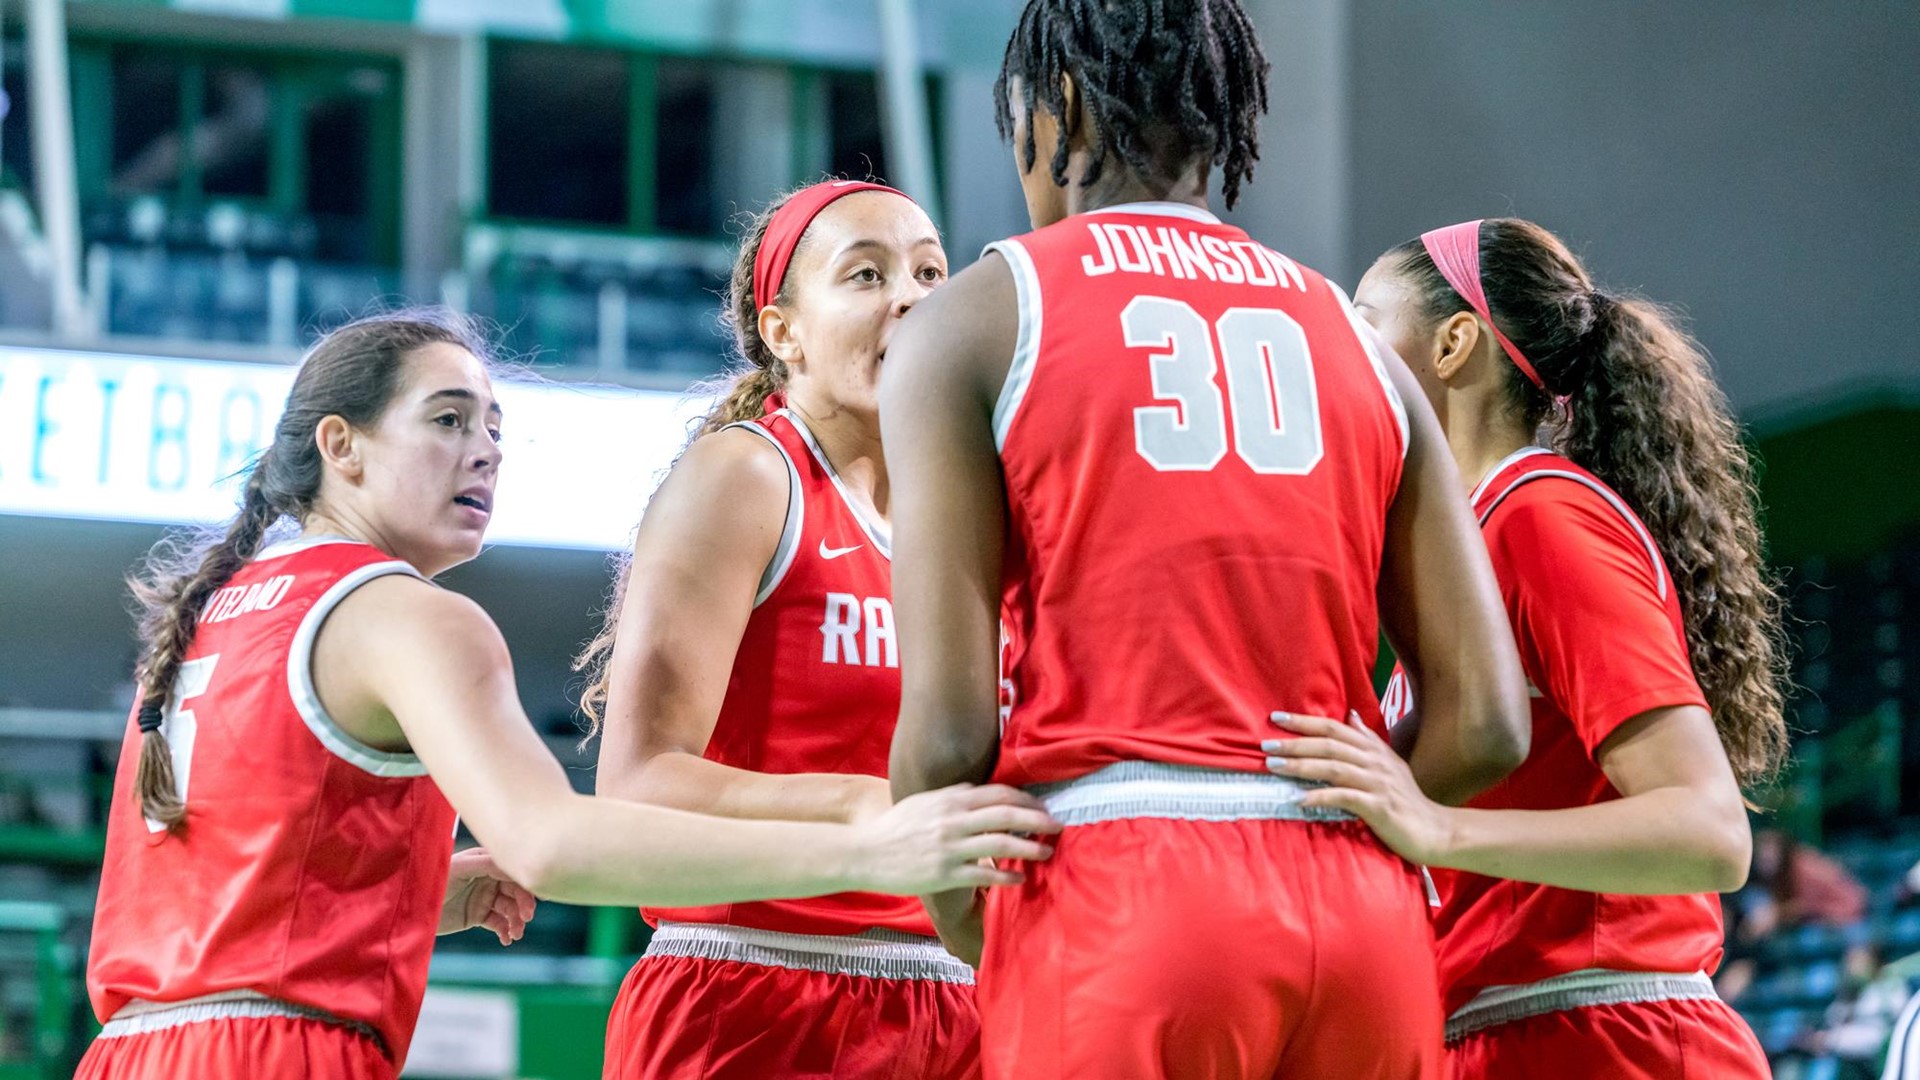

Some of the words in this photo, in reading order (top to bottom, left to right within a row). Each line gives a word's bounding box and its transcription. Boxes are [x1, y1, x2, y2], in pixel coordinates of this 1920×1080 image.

[1081, 223, 1307, 293] JOHNSON
[0, 373, 266, 492] ETBA
[1120, 295, 1325, 475] 30
